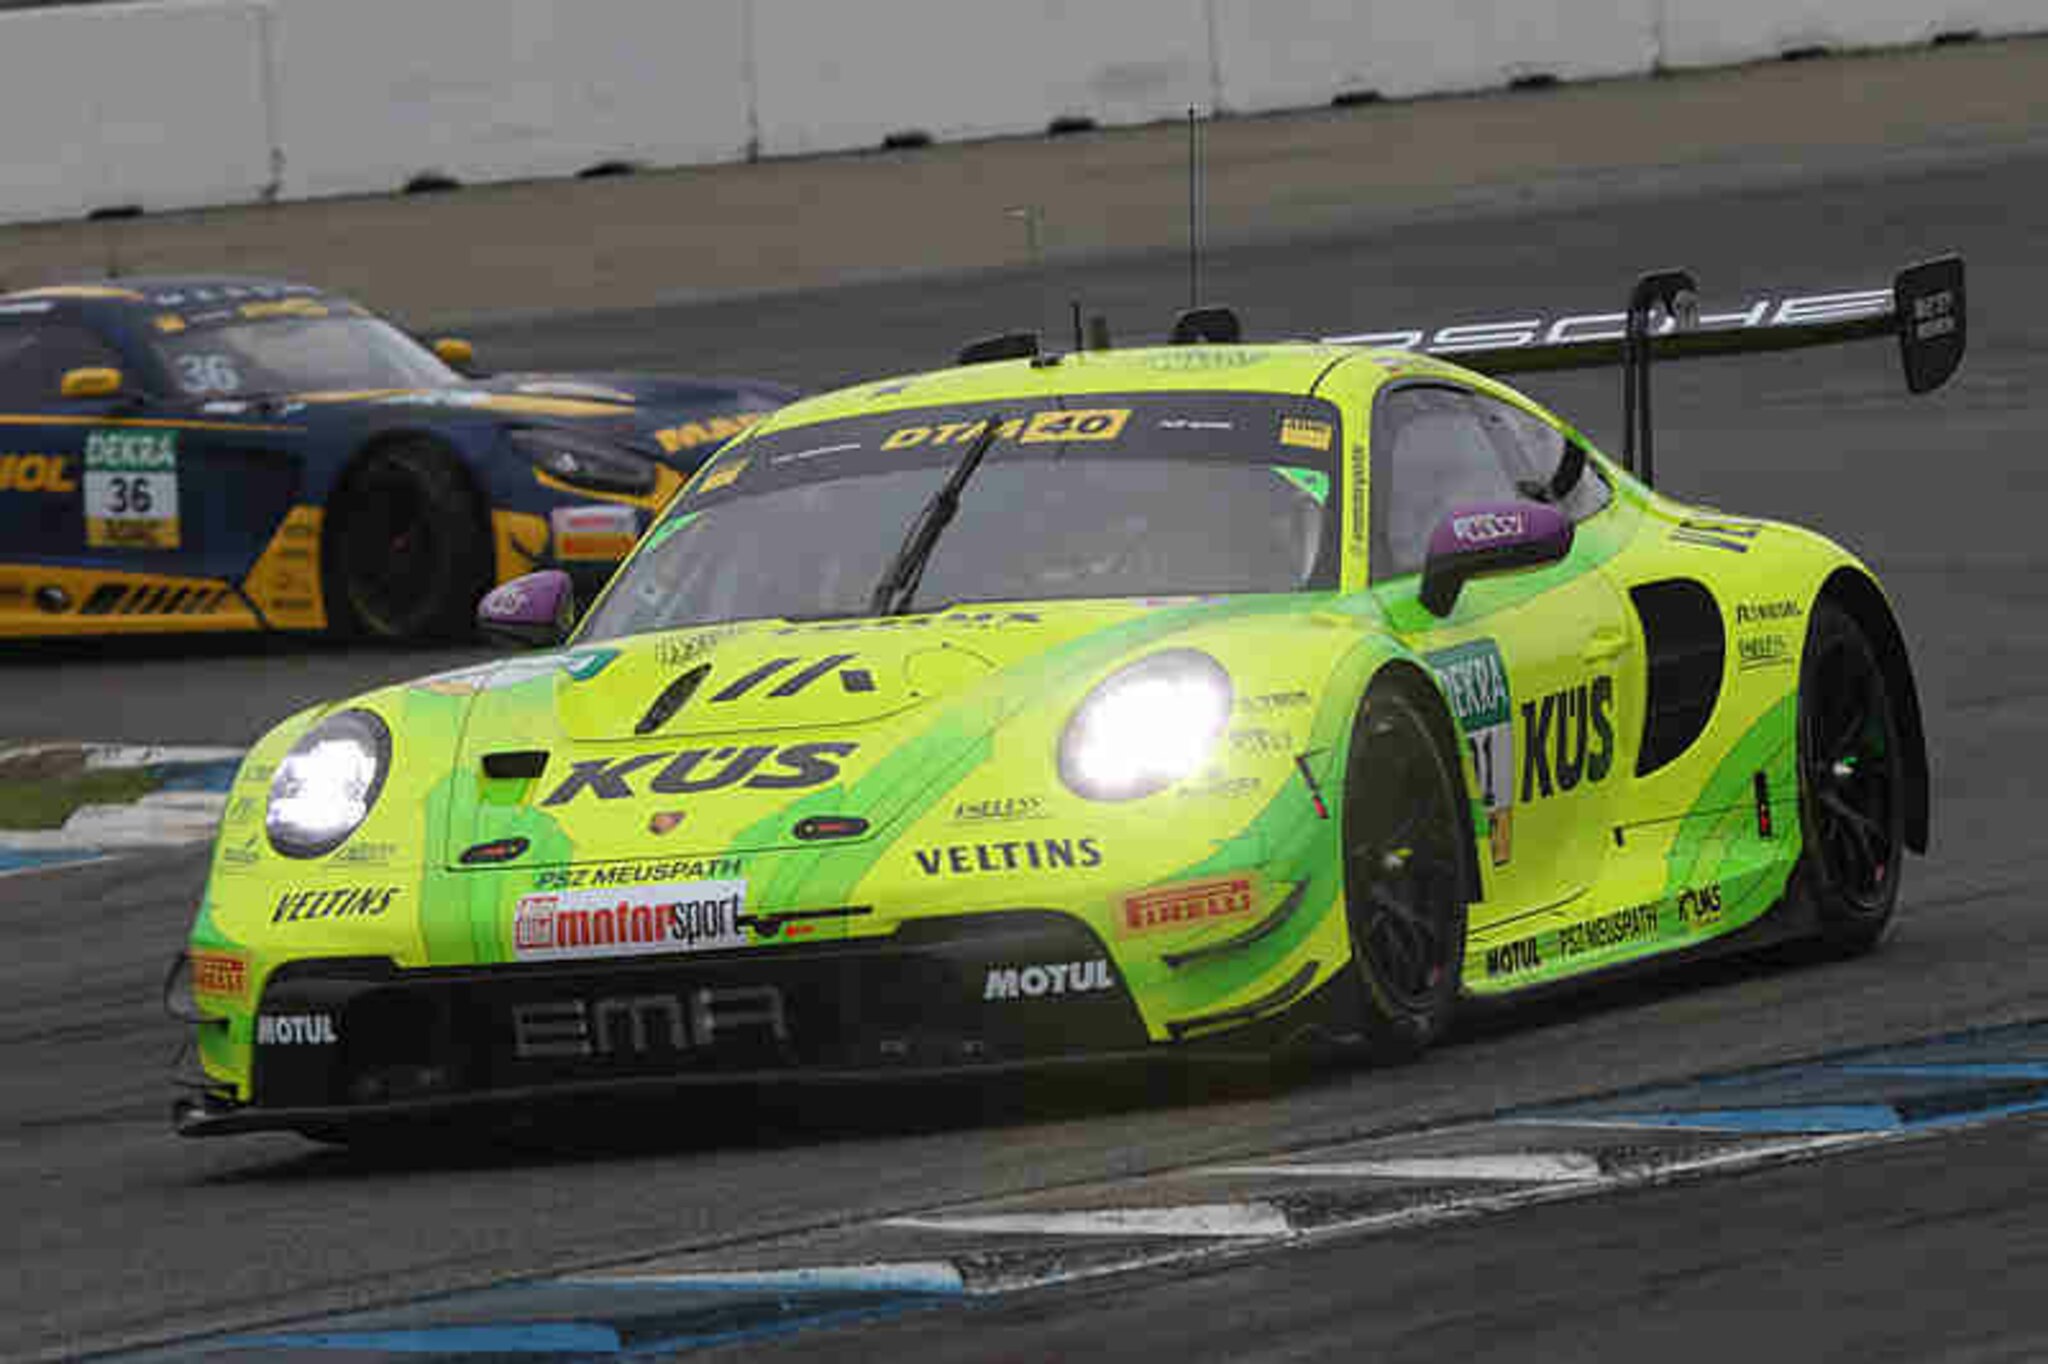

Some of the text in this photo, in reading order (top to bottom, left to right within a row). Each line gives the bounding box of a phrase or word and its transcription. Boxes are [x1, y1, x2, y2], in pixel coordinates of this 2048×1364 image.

[178, 354, 240, 391] 36
[86, 433, 175, 466] DEKRA
[106, 476, 153, 513] 36
[591, 858, 741, 885] MEUSPATH
[915, 838, 1103, 876] VELTINS
[271, 886, 400, 923] VELTINS
[1487, 936, 1541, 976] MOTUL
[984, 959, 1114, 1000] MOTUL
[257, 1013, 338, 1045] MOTUL
[512, 985, 788, 1058] EMA
